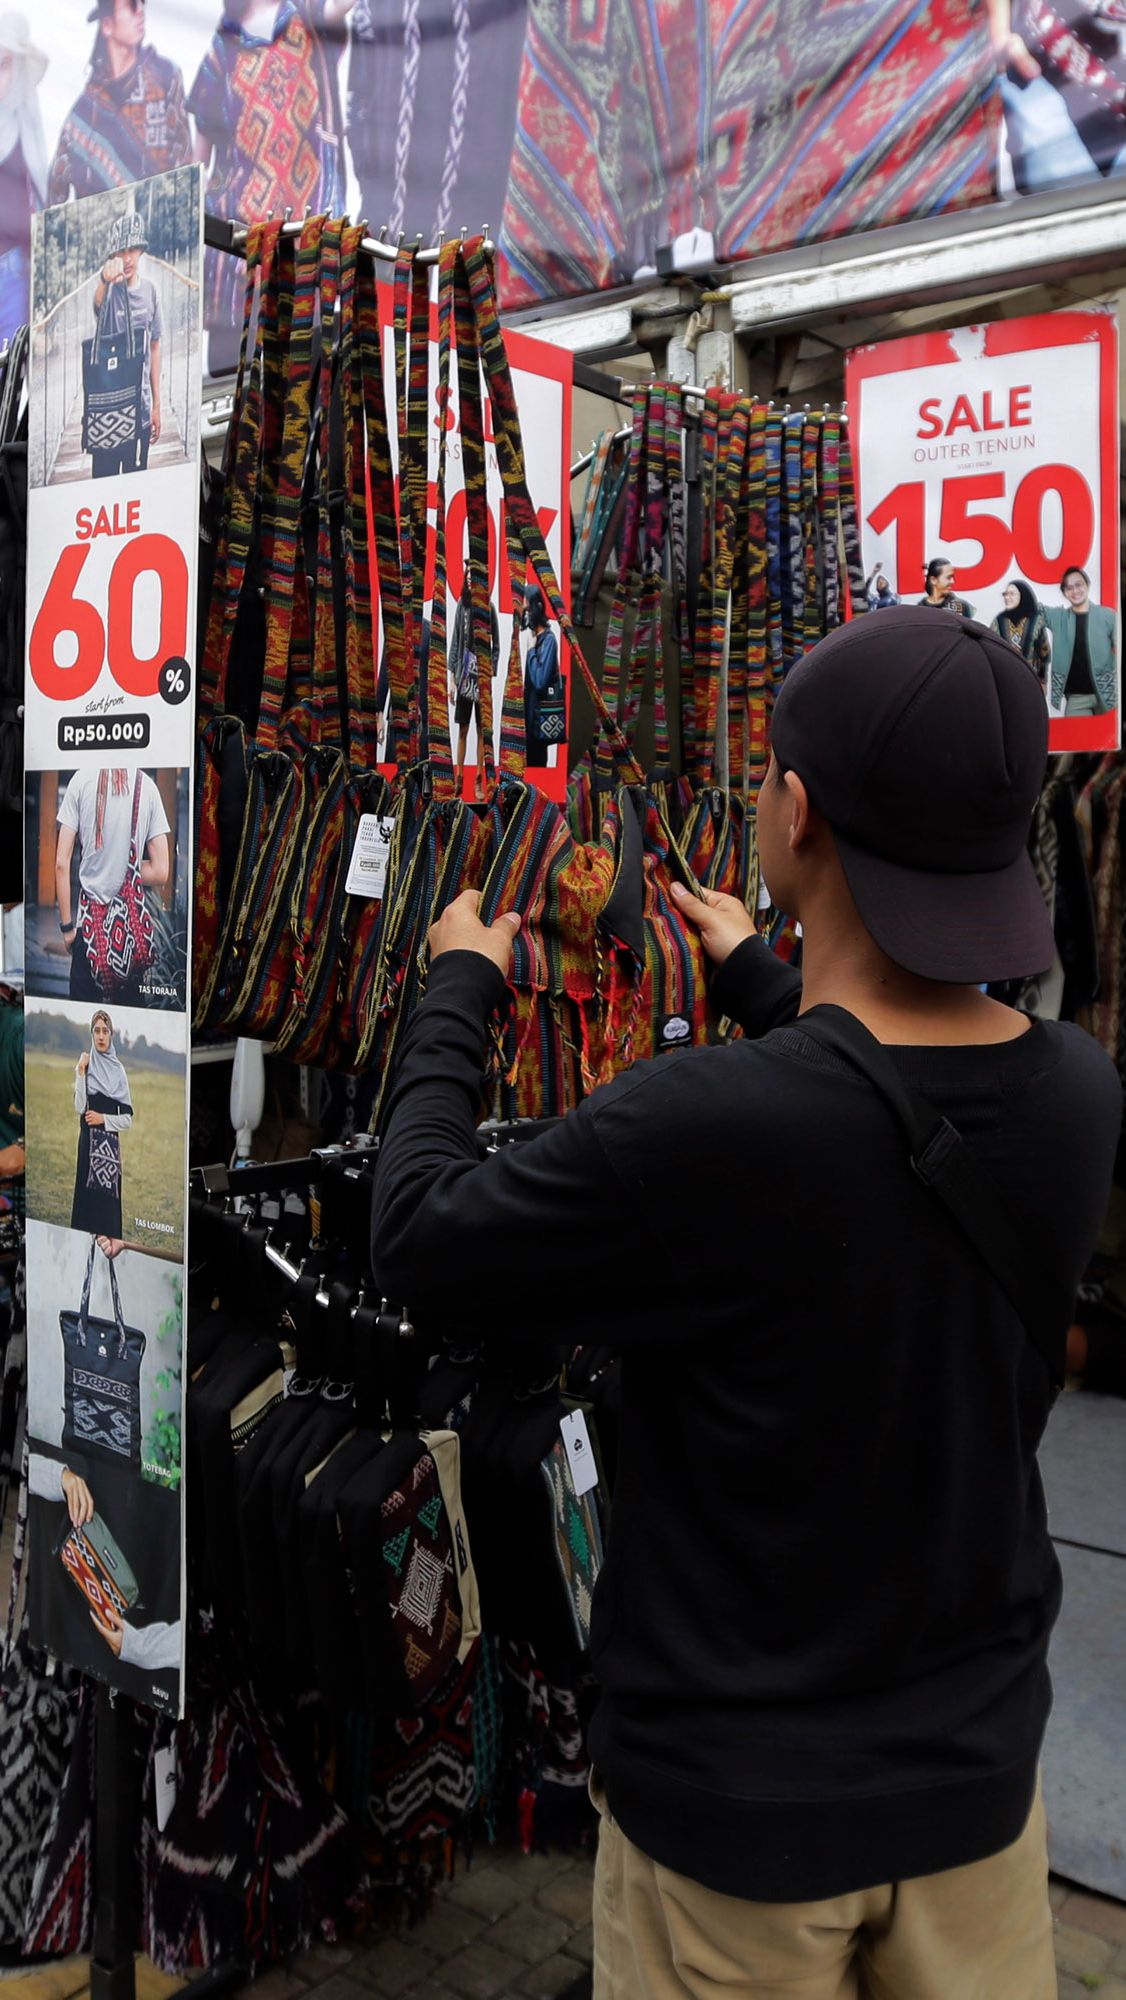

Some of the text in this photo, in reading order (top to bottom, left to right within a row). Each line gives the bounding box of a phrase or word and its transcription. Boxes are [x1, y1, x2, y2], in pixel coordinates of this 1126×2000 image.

[917, 384, 1032, 440] SALE
[914, 434, 1036, 463] OUTER TENUN
[75, 500, 141, 541] SALE
[866, 462, 1095, 595] 150
[29, 533, 189, 701] 60 %
[85, 694, 125, 714] start from
[63, 722, 144, 746] Rp50.000
[138, 985, 178, 997] TAS TORAJA
[135, 1217, 175, 1234] TAS LOMBOK
[143, 1462, 171, 1478] TOTEBAG
